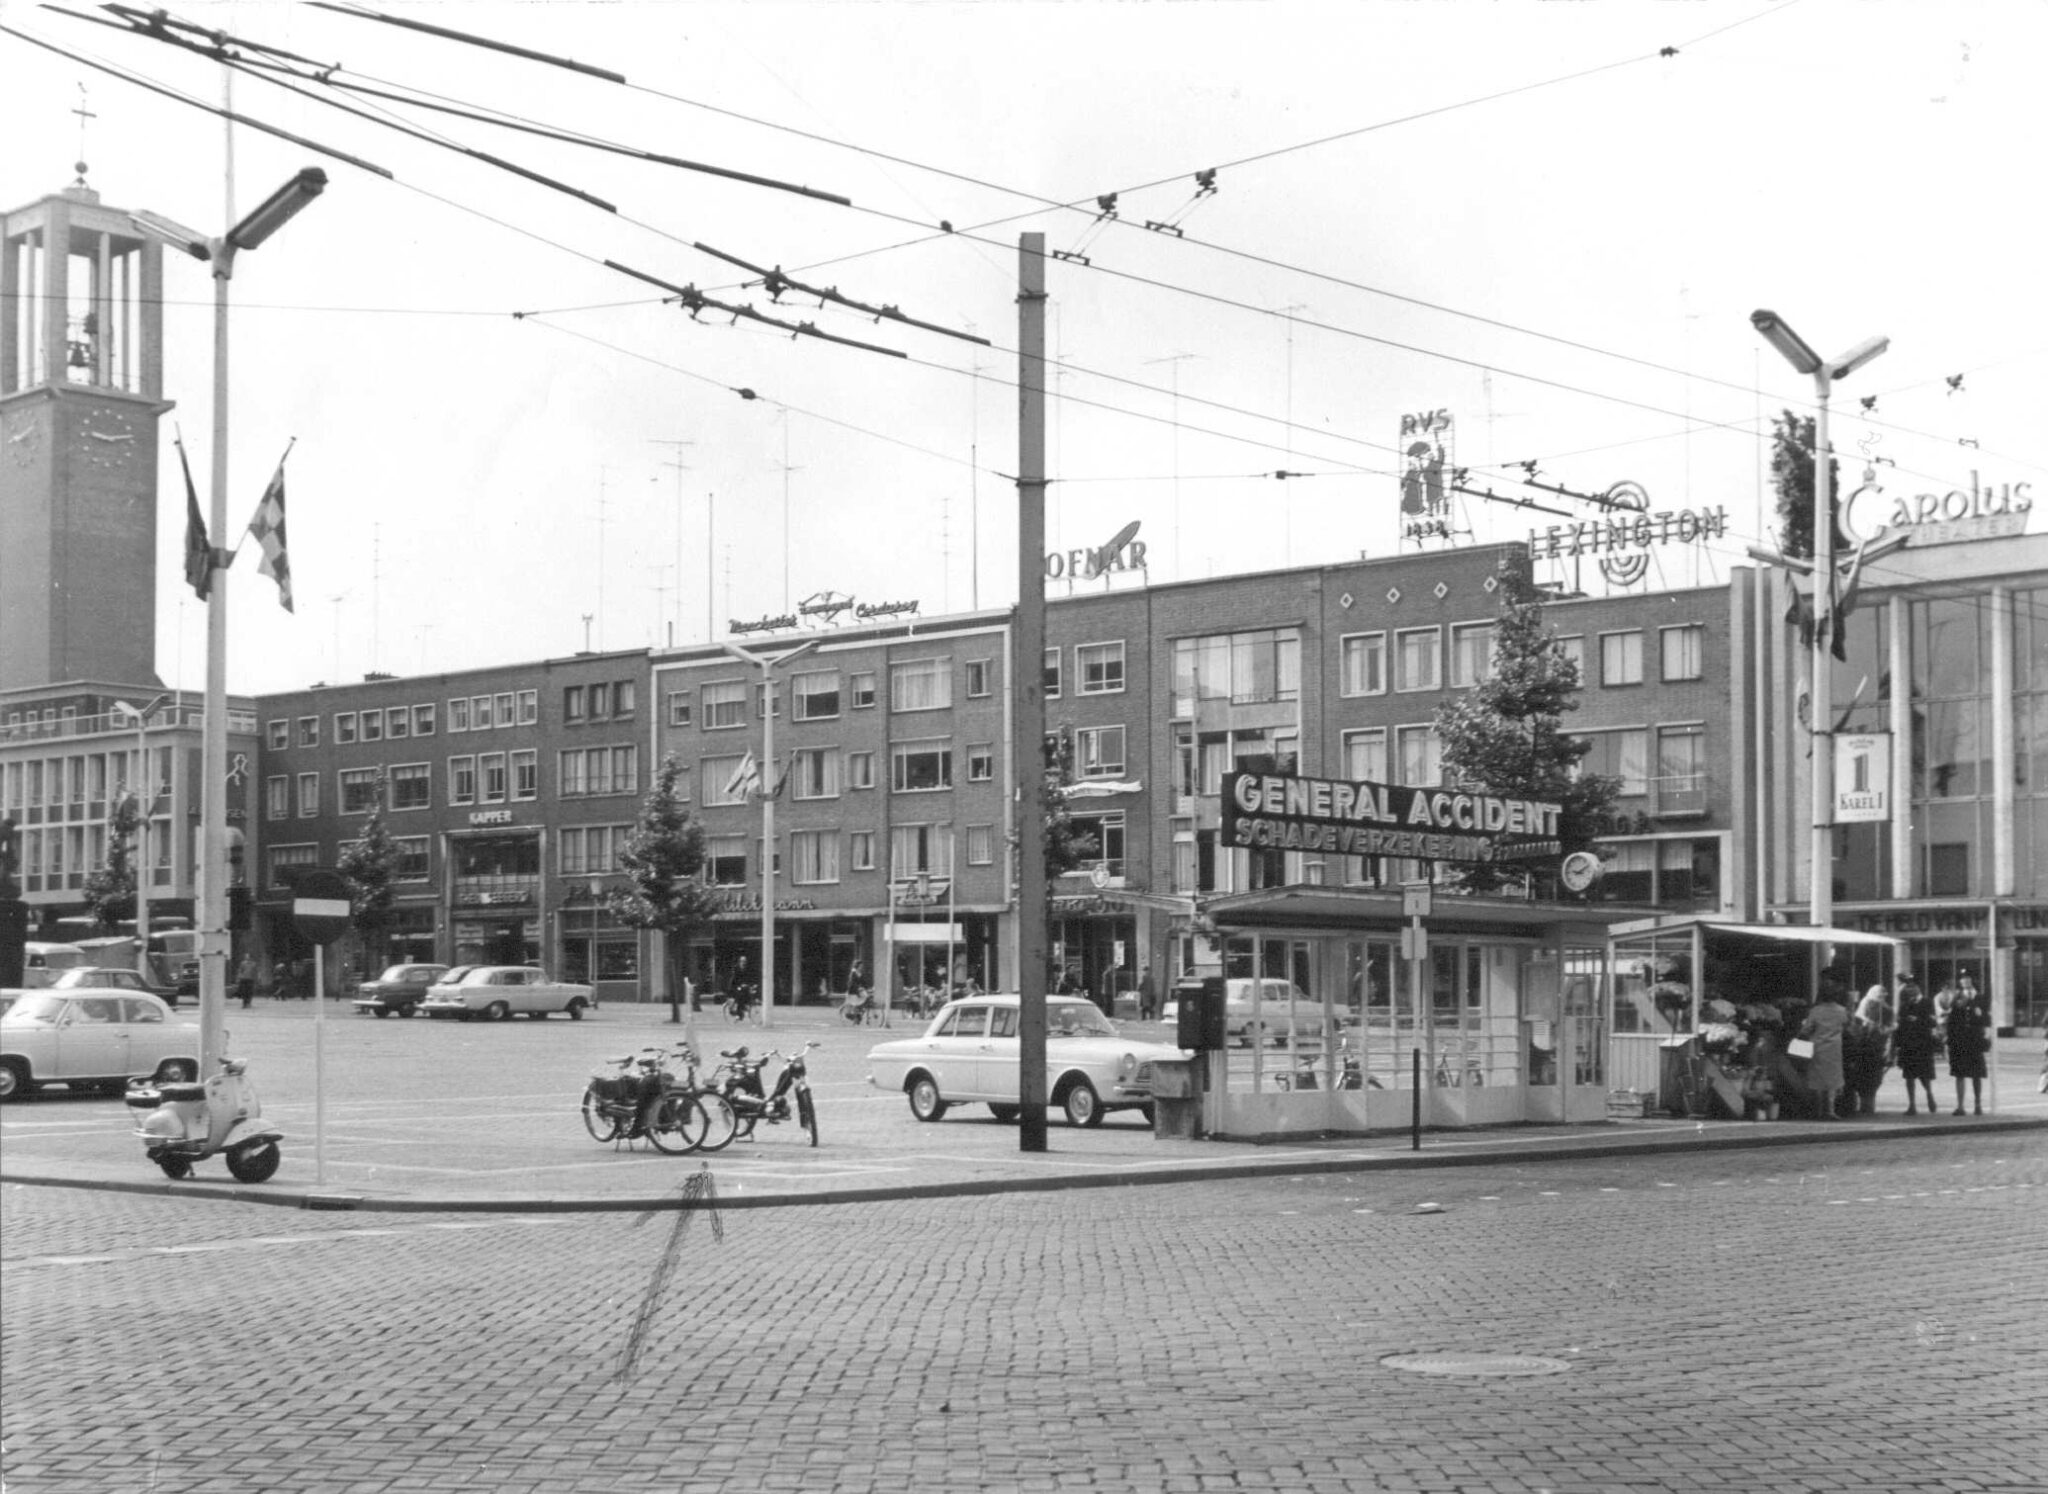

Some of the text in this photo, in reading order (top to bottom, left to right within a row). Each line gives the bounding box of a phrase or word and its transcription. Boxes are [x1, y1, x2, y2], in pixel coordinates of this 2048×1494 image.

[1401, 408, 1450, 436] RVS
[1528, 504, 1725, 560] LEXINGTON
[1045, 541, 1147, 580] OFNAR
[468, 810, 513, 825] KAPPER
[1234, 773, 1398, 823] GENERAL
[1407, 790, 1563, 836] ACCIDENT
[1234, 817, 1495, 863] SCHADEVERZEKERING
